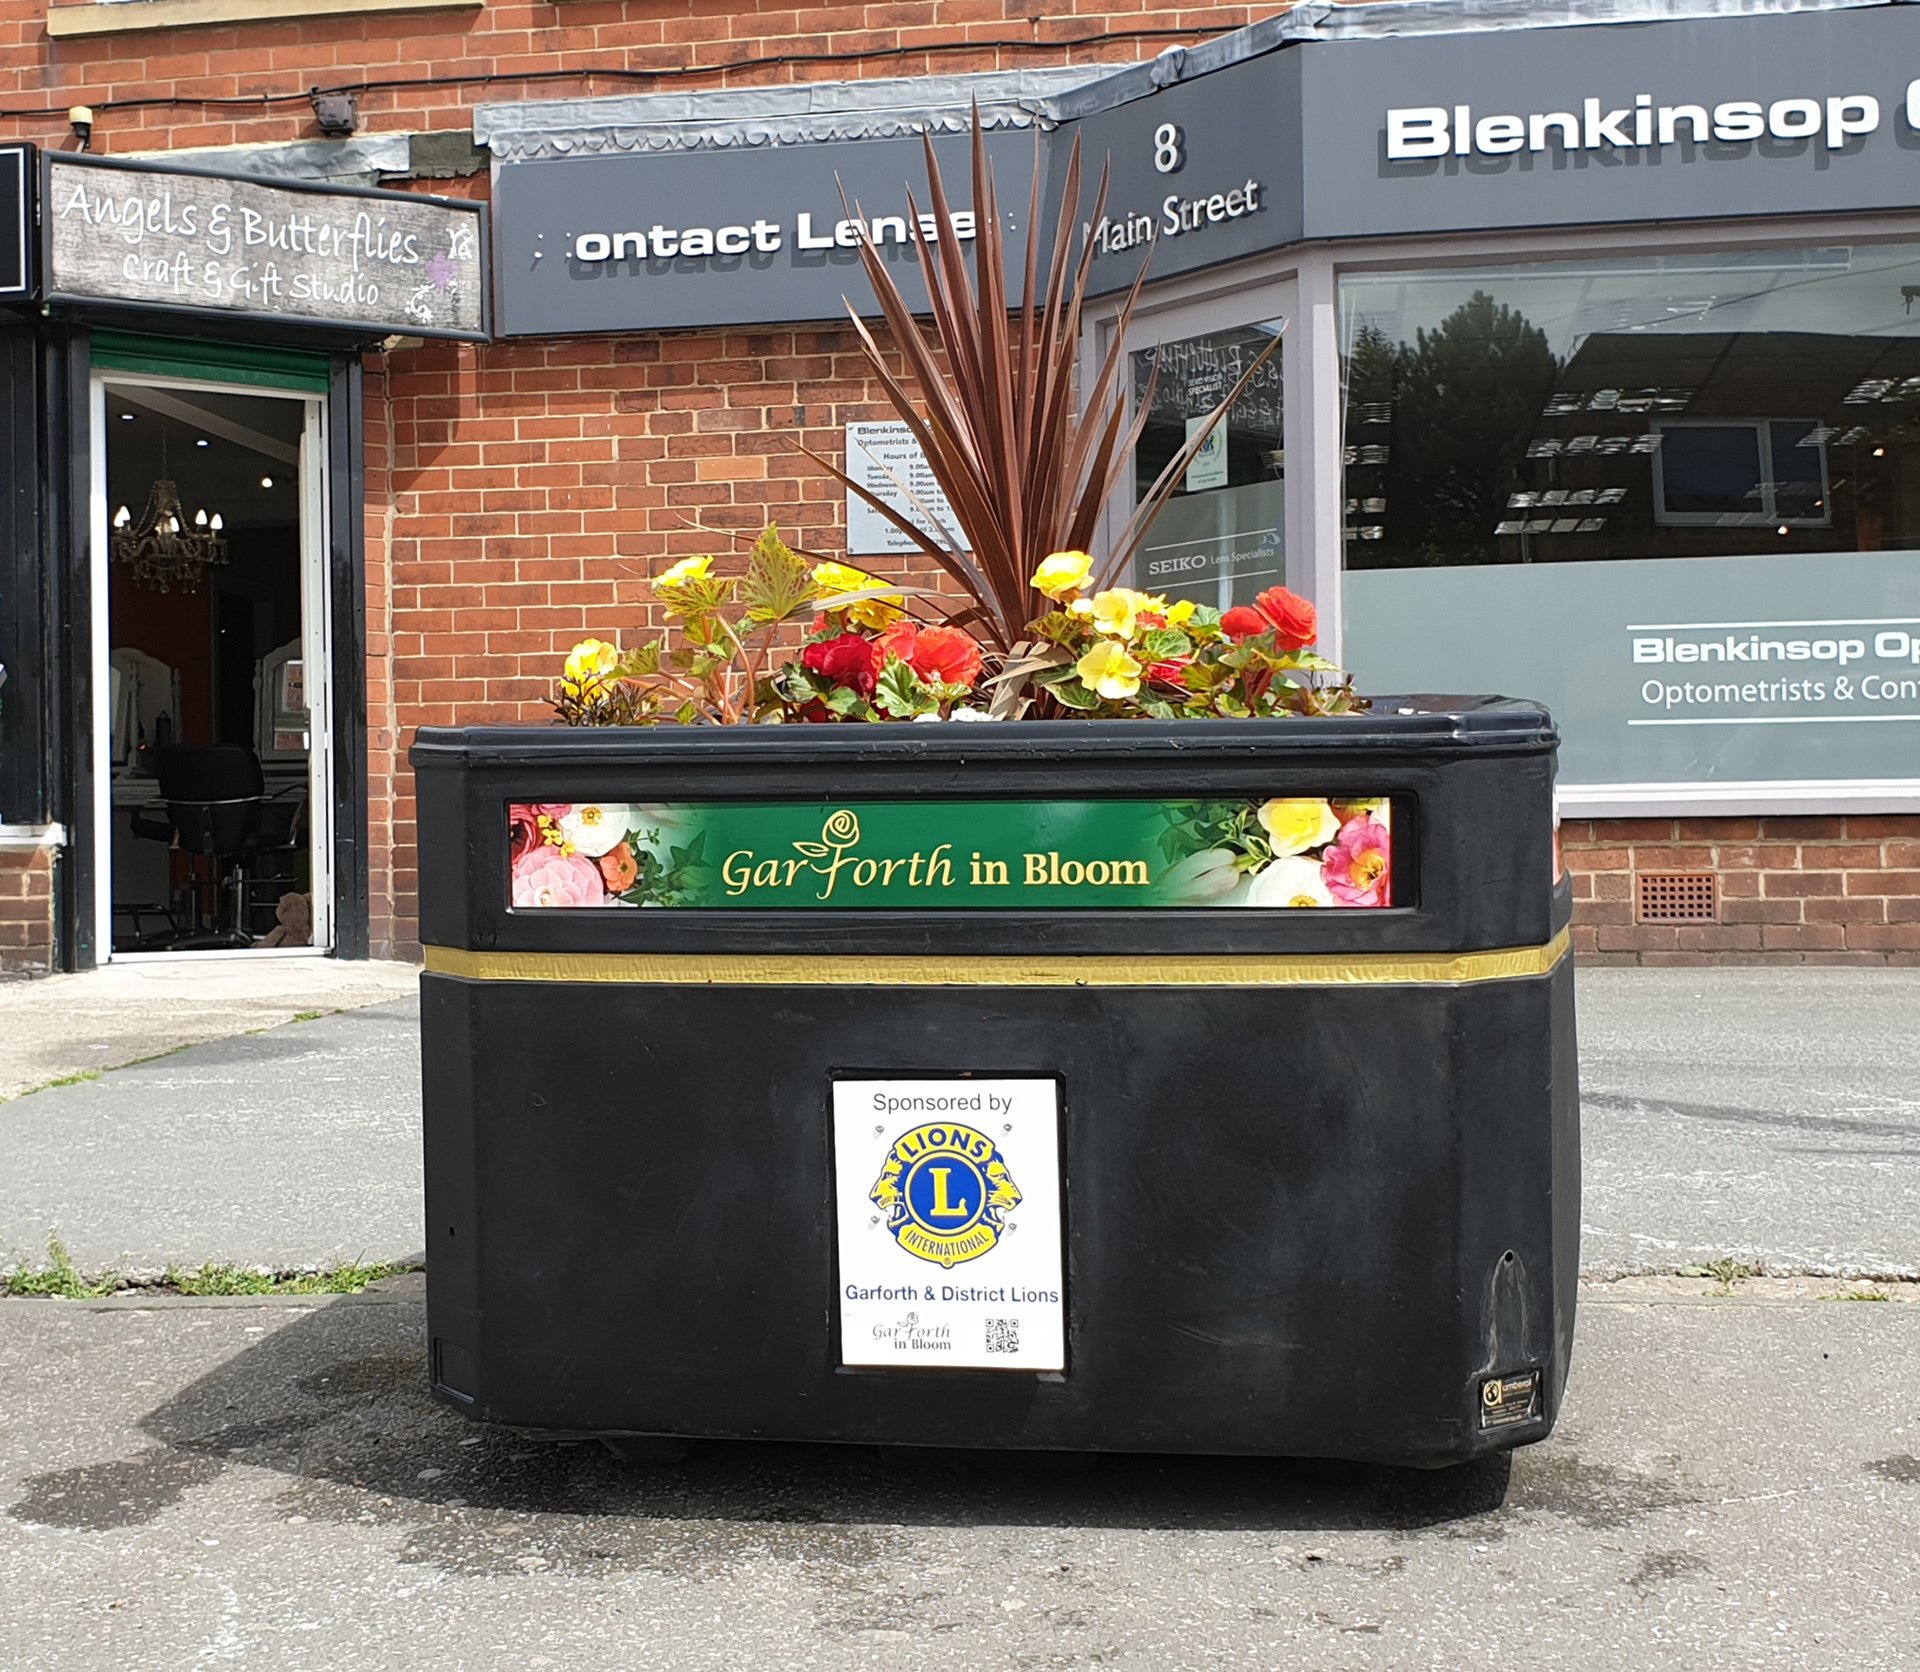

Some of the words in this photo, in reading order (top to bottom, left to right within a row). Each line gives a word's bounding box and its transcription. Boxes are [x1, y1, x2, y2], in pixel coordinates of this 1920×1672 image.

[1387, 94, 1880, 159] Blenkinsop
[1154, 122, 1178, 173] 8
[60, 184, 198, 244] Angels
[239, 207, 420, 272] Butterflies
[1083, 211, 1152, 253] Main
[1163, 178, 1258, 236] Street
[575, 219, 782, 262] ontact
[123, 251, 195, 295] Craft
[229, 261, 282, 305] Gift
[289, 273, 379, 305] Studio
[857, 426, 913, 435] Blenkinso
[1149, 555, 1206, 575] SEIKO
[1211, 555, 1230, 565] Lens
[1231, 548, 1275, 562] Specialists
[1632, 636, 1865, 666] Blenkinsop
[1641, 677, 1826, 710] Optometrists
[1833, 676, 1855, 701] &
[1861, 675, 1920, 700] Con
[722, 809, 956, 900] Garforth
[970, 852, 1010, 886] in
[1023, 852, 1150, 886] Bloom
[873, 1093, 981, 1114] Sponsored
[989, 1093, 1012, 1114] by
[901, 1128, 988, 1158] LIONS
[929, 1167, 968, 1217] L
[904, 1229, 989, 1256] INTERNATIONAL
[845, 1284, 918, 1301] Garforth
[924, 1286, 935, 1301] &
[942, 1285, 1006, 1302] District
[1011, 1286, 1058, 1303] Lions
[872, 1312, 950, 1341] Garforth
[894, 1338, 907, 1350] in
[912, 1338, 951, 1350] Bloom
